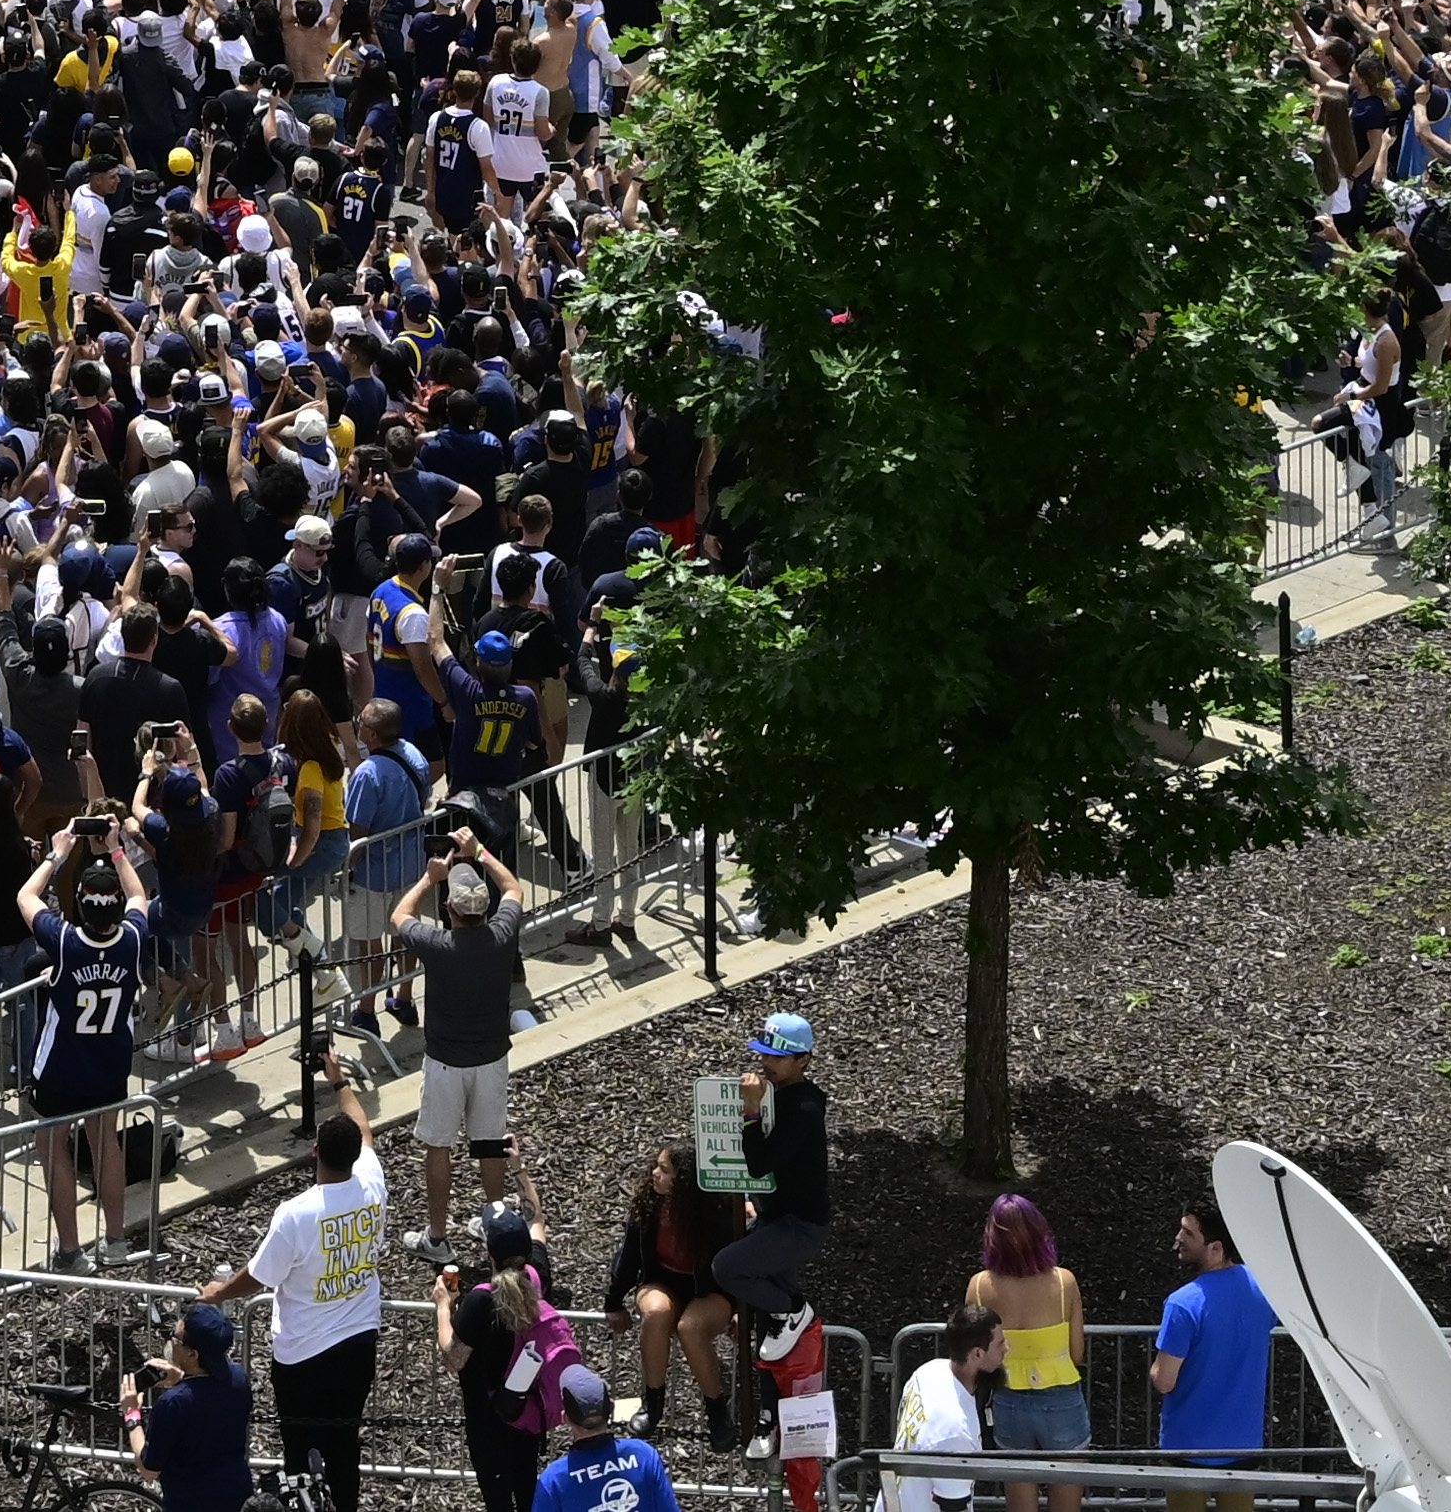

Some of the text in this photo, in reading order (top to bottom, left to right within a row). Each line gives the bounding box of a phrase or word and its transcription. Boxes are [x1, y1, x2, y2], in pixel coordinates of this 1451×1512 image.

[495, 6, 512, 23] 24
[497, 94, 529, 109] MURRAY
[500, 109, 523, 136] 27
[440, 141, 460, 169] 27
[343, 197, 364, 221] 27
[592, 440, 614, 470] 15
[475, 702, 527, 719] ANDERSEN
[475, 720, 514, 754] 11
[72, 963, 127, 986] MURRAY
[76, 987, 122, 1035] 27
[700, 1103, 768, 1117] SUPERVR
[701, 1121, 743, 1134] VEHICLES
[707, 1138, 727, 1152] ALL
[322, 1204, 381, 1250] BITCH
[806, 1422, 829, 1430] Parking
[569, 1454, 638, 1484] TEAM
